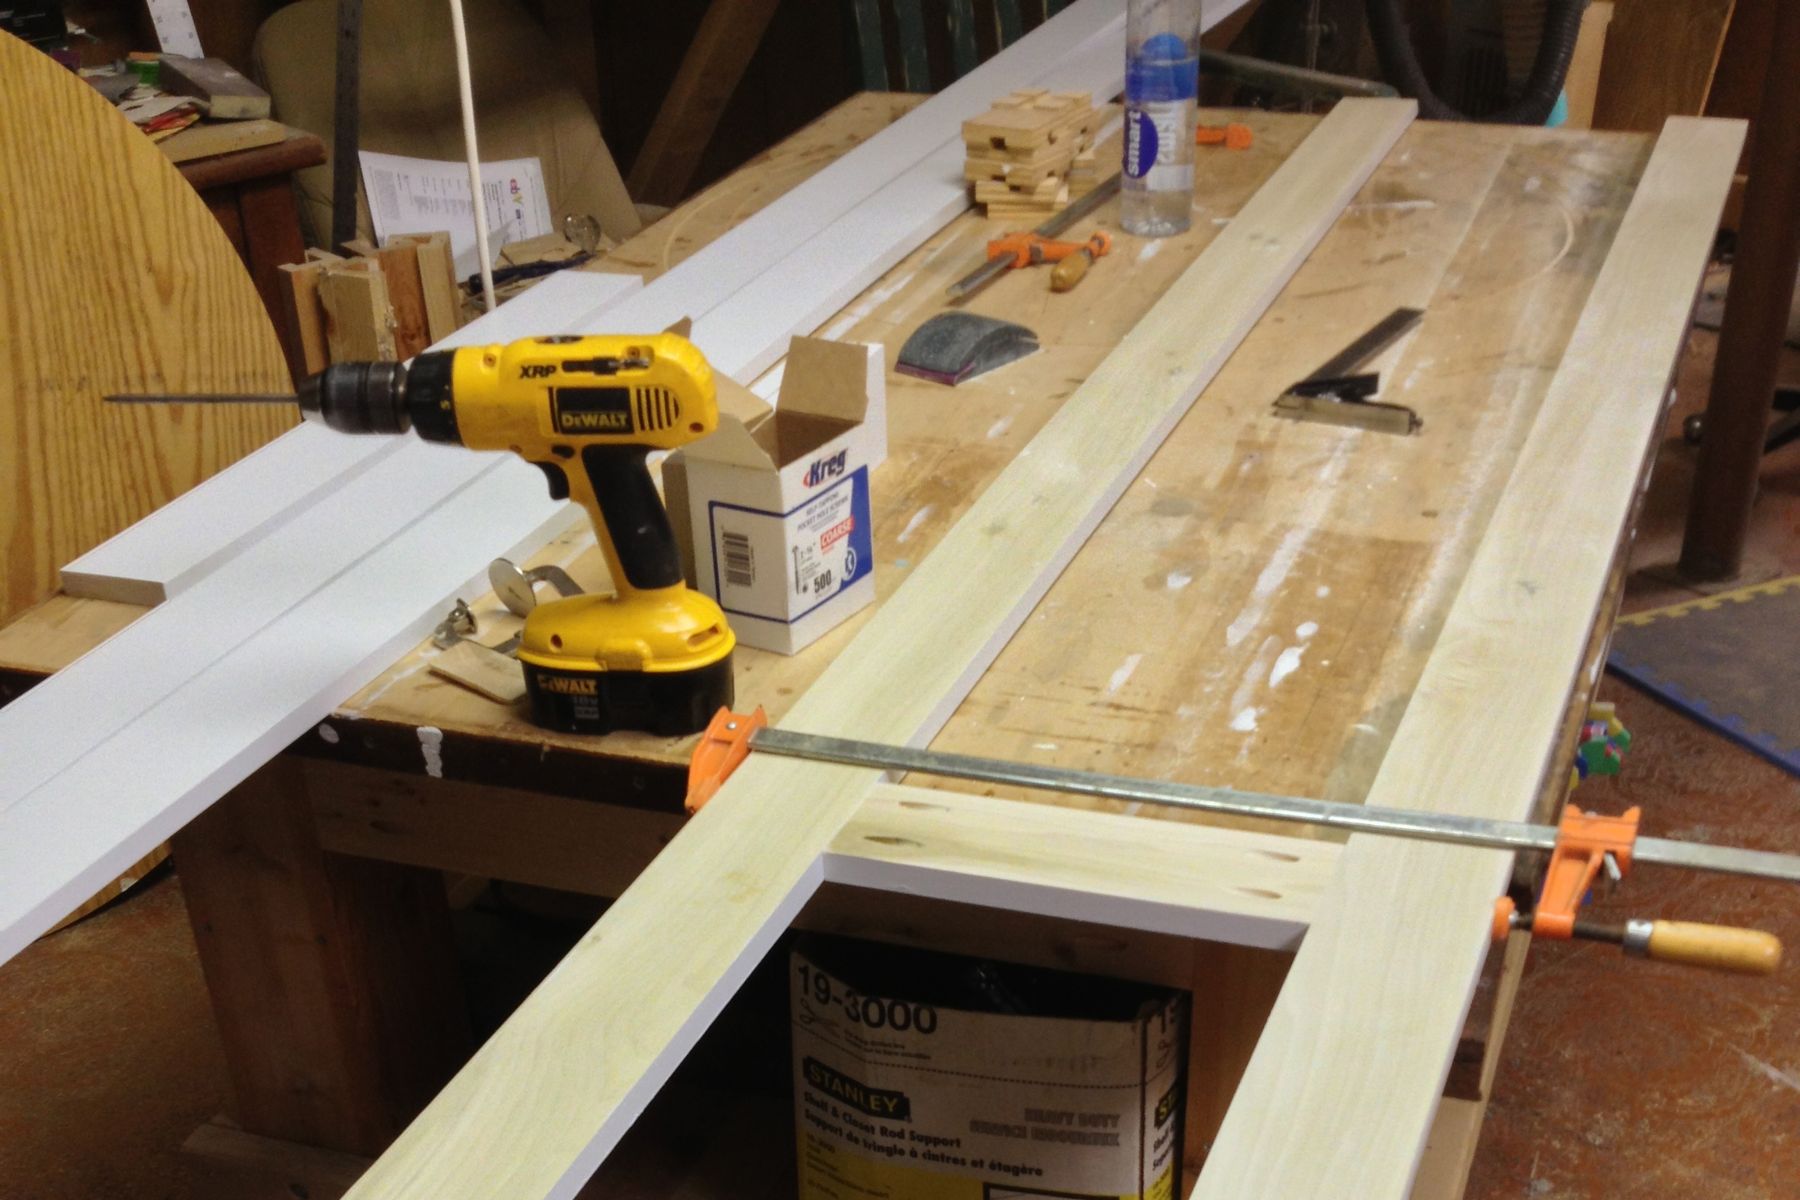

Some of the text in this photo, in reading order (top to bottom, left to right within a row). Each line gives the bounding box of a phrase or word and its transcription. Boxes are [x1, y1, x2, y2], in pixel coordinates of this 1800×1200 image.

[1127, 111, 1142, 177] smart
[519, 365, 558, 380] XRP
[809, 448, 848, 488] Kreg
[814, 569, 832, 594] 500
[798, 965, 937, 1035] 19-3000
[808, 1062, 899, 1114] STANLEY
[846, 1130, 860, 1145] de
[863, 1139, 906, 1157] tringle
[922, 1149, 967, 1167] cintres
[970, 1157, 985, 1169] et
[879, 1126, 905, 1140] Rod
[909, 1129, 961, 1149] Support
